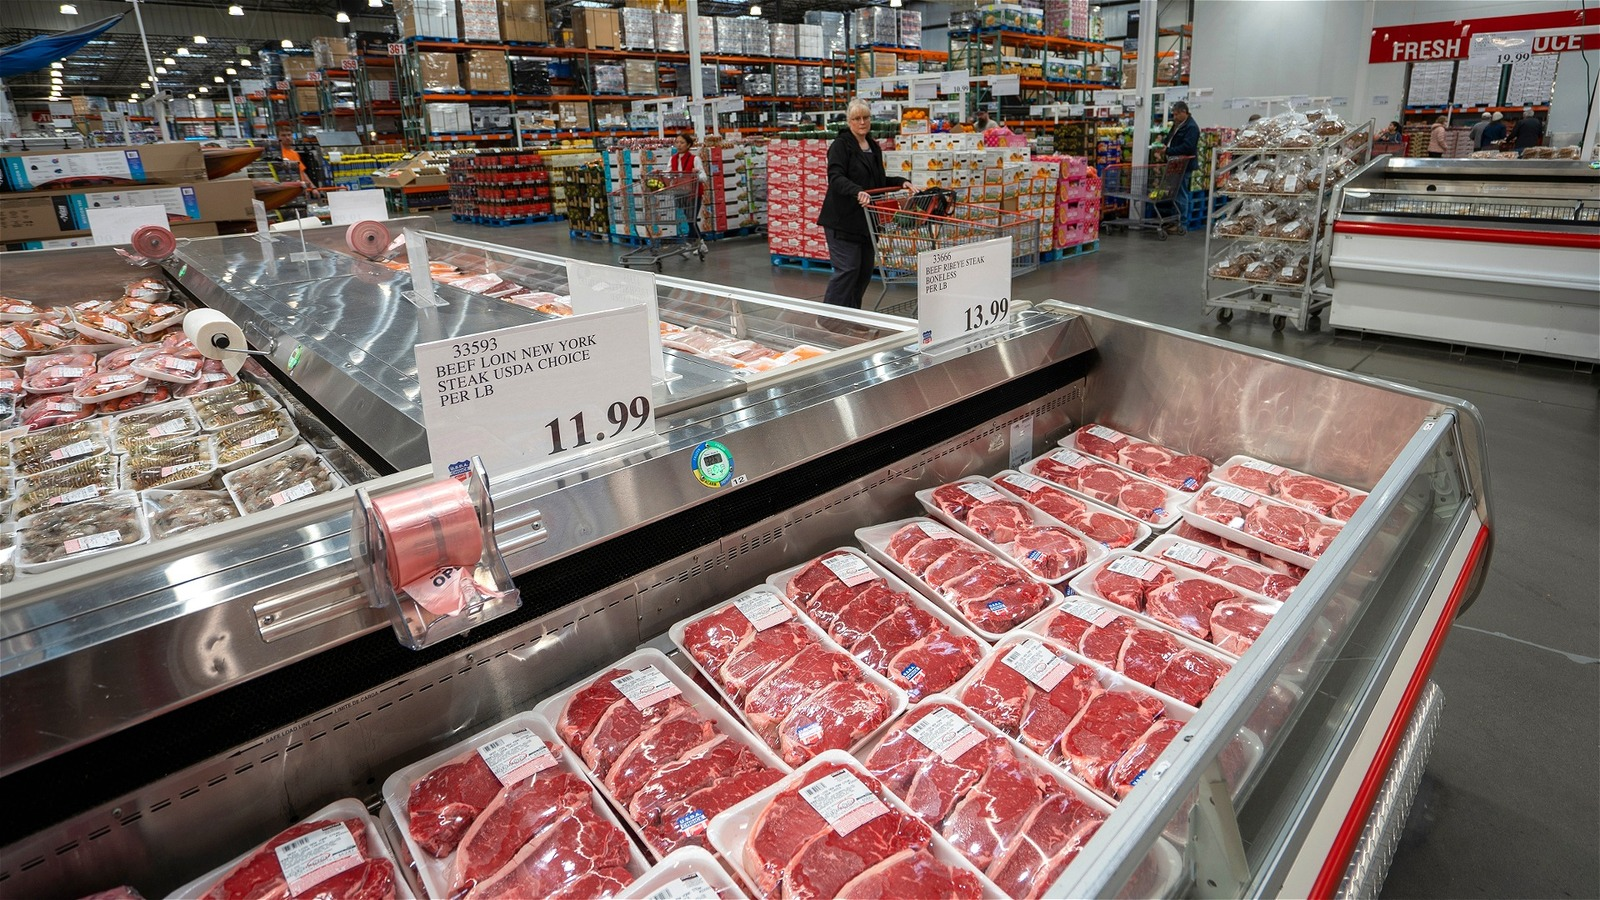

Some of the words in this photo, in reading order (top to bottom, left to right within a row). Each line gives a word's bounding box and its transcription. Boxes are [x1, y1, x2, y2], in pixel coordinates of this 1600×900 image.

[389, 44, 405, 55] 361
[1392, 38, 1461, 61] FRESH
[1534, 35, 1582, 52] UCE
[1497, 52, 1530, 64] 19.99
[953, 85, 969, 93] 10.99
[925, 265, 942, 275] BEEF
[943, 259, 965, 271] RIBEYE
[965, 256, 985, 267] STEAK
[932, 251, 952, 264] 33666
[925, 271, 957, 285] BONELESS
[925, 284, 938, 294] PER
[939, 282, 948, 291] LB
[964, 297, 1009, 332] 13.99
[436, 359, 477, 378] BEEF
[481, 350, 517, 369] LOIN
[521, 342, 555, 359] NEW
[559, 334, 597, 353] YORK
[452, 337, 498, 359] 33593
[437, 372, 489, 393] STEAK
[494, 363, 534, 381] USDA
[537, 349, 591, 371] CHOICE
[440, 390, 471, 407] PER
[474, 384, 494, 399] LB
[544, 395, 651, 456] 11.99
[733, 476, 745, 485] 12
[360, 691, 379, 703] CARGA
[265, 733, 281, 744] SAFE
[281, 726, 298, 738] LOAD
[298, 720, 312, 730] LINE
